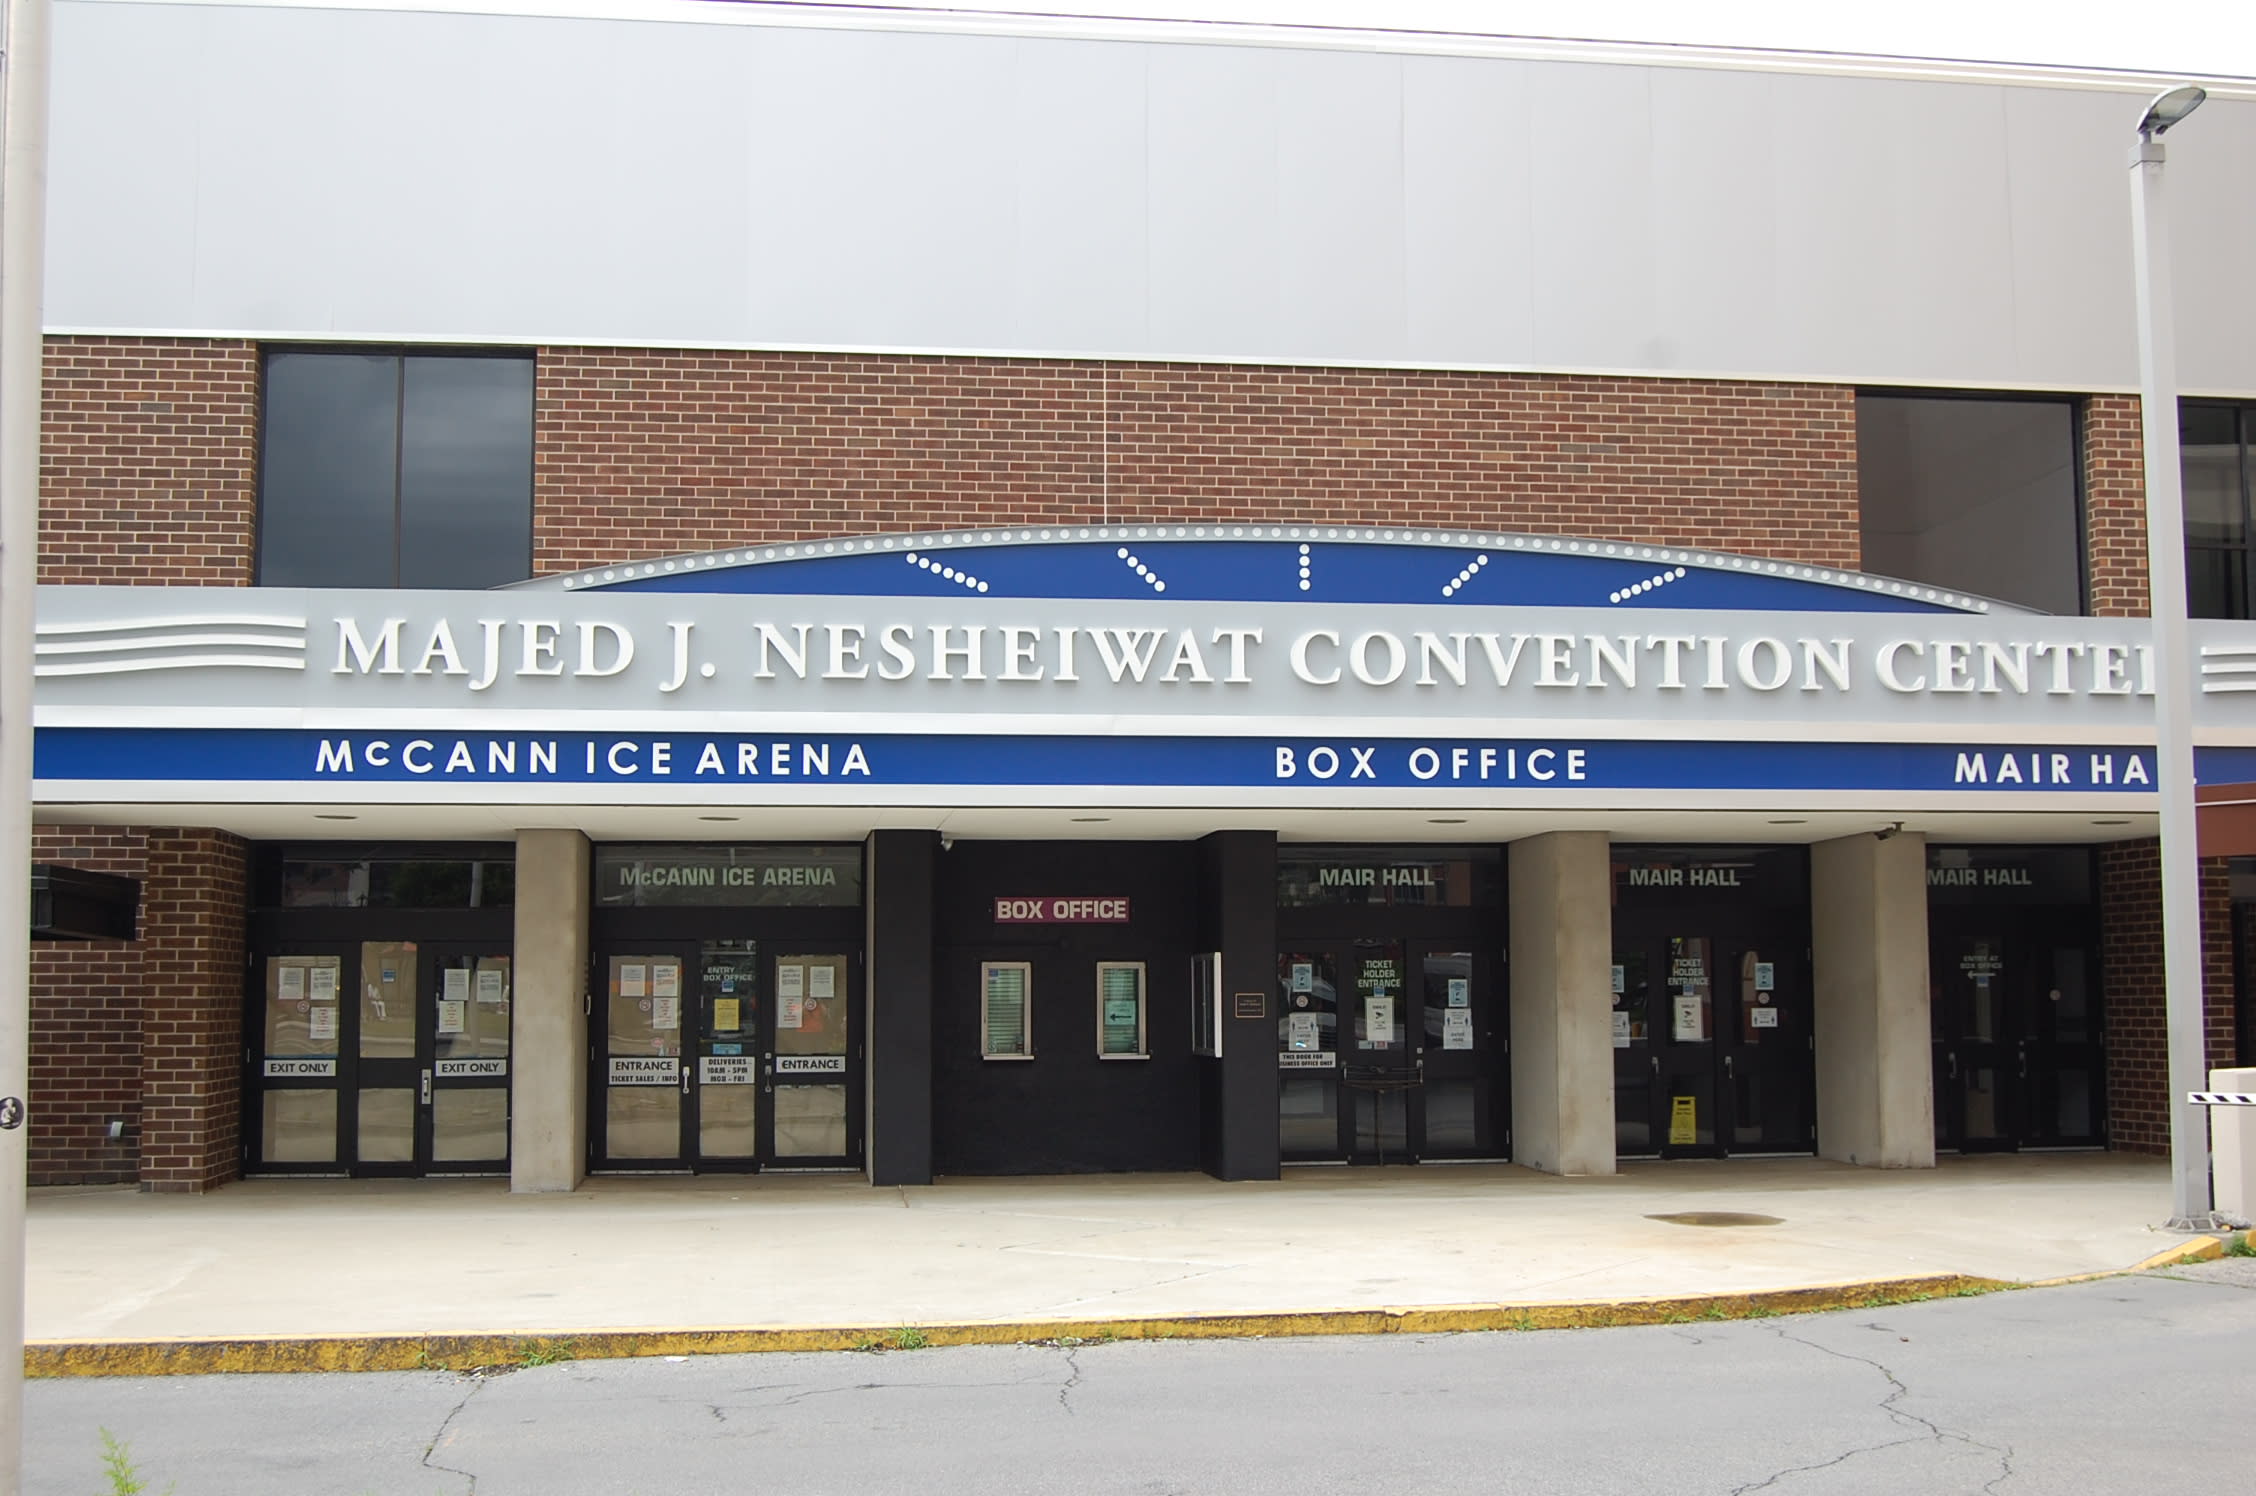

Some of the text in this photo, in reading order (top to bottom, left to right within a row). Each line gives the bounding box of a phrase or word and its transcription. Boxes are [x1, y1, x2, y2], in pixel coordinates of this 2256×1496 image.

[331, 617, 635, 692] MAJED
[658, 621, 716, 693] J.
[753, 623, 1263, 686] NESHEIWAT
[1290, 630, 1856, 692] CONVENTION
[585, 741, 671, 776] ICE
[695, 742, 872, 777] ARENA
[1276, 746, 1587, 782] BOX OFFICE
[1954, 752, 2150, 785] MAIR HA
[620, 868, 835, 886] McCANN ICE ARENA
[1320, 869, 1434, 886] MAIR HALL
[1630, 869, 1740, 886] MAIR HALL
[1927, 868, 2032, 885] MAIR HALL
[997, 900, 1126, 919] BOX OFFICE
[1365, 960, 1392, 968] TICKET
[1674, 959, 1702, 967] TICKET
[1364, 970, 1395, 978] HOLDER
[1673, 968, 1704, 976] HOLDER
[1358, 979, 1400, 988] ENTRANCE
[1668, 977, 1709, 986] ENTRANCE
[271, 1064, 328, 1073] EXIT ONLY
[442, 1063, 499, 1073] EXIT ONLY
[616, 1062, 672, 1071] ENTRANCE
[782, 1060, 839, 1069] ENTRANCE
